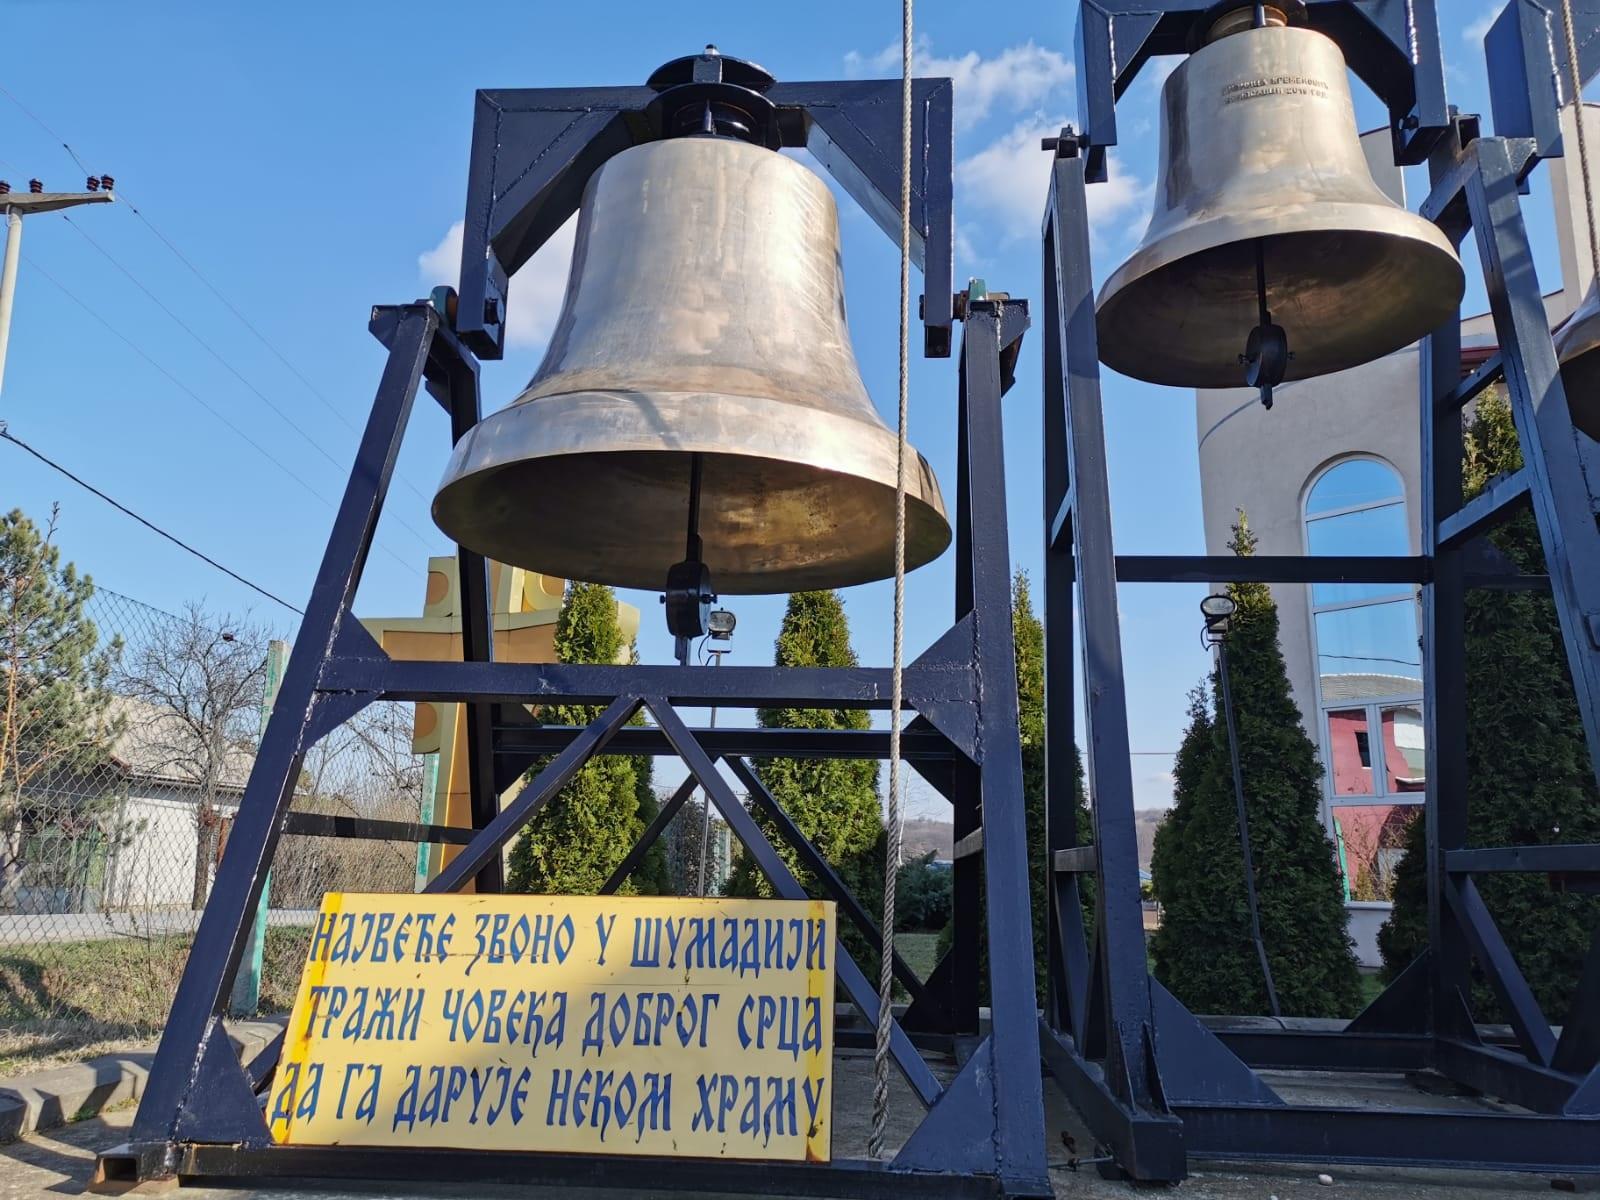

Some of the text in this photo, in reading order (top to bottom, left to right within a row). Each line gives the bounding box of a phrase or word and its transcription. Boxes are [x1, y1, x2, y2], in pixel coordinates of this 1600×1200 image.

[309, 912, 827, 978] НАЈВЕЋЕ ЗВОНО У ШУМАДИЈИ
[305, 985, 823, 1062] ТРАЖИ ЧОВЕКА ДОБРОГ СРЦА
[272, 1062, 826, 1148] ДА ГА ДАРУЈЕ НЕКОМ ХРАМУ
